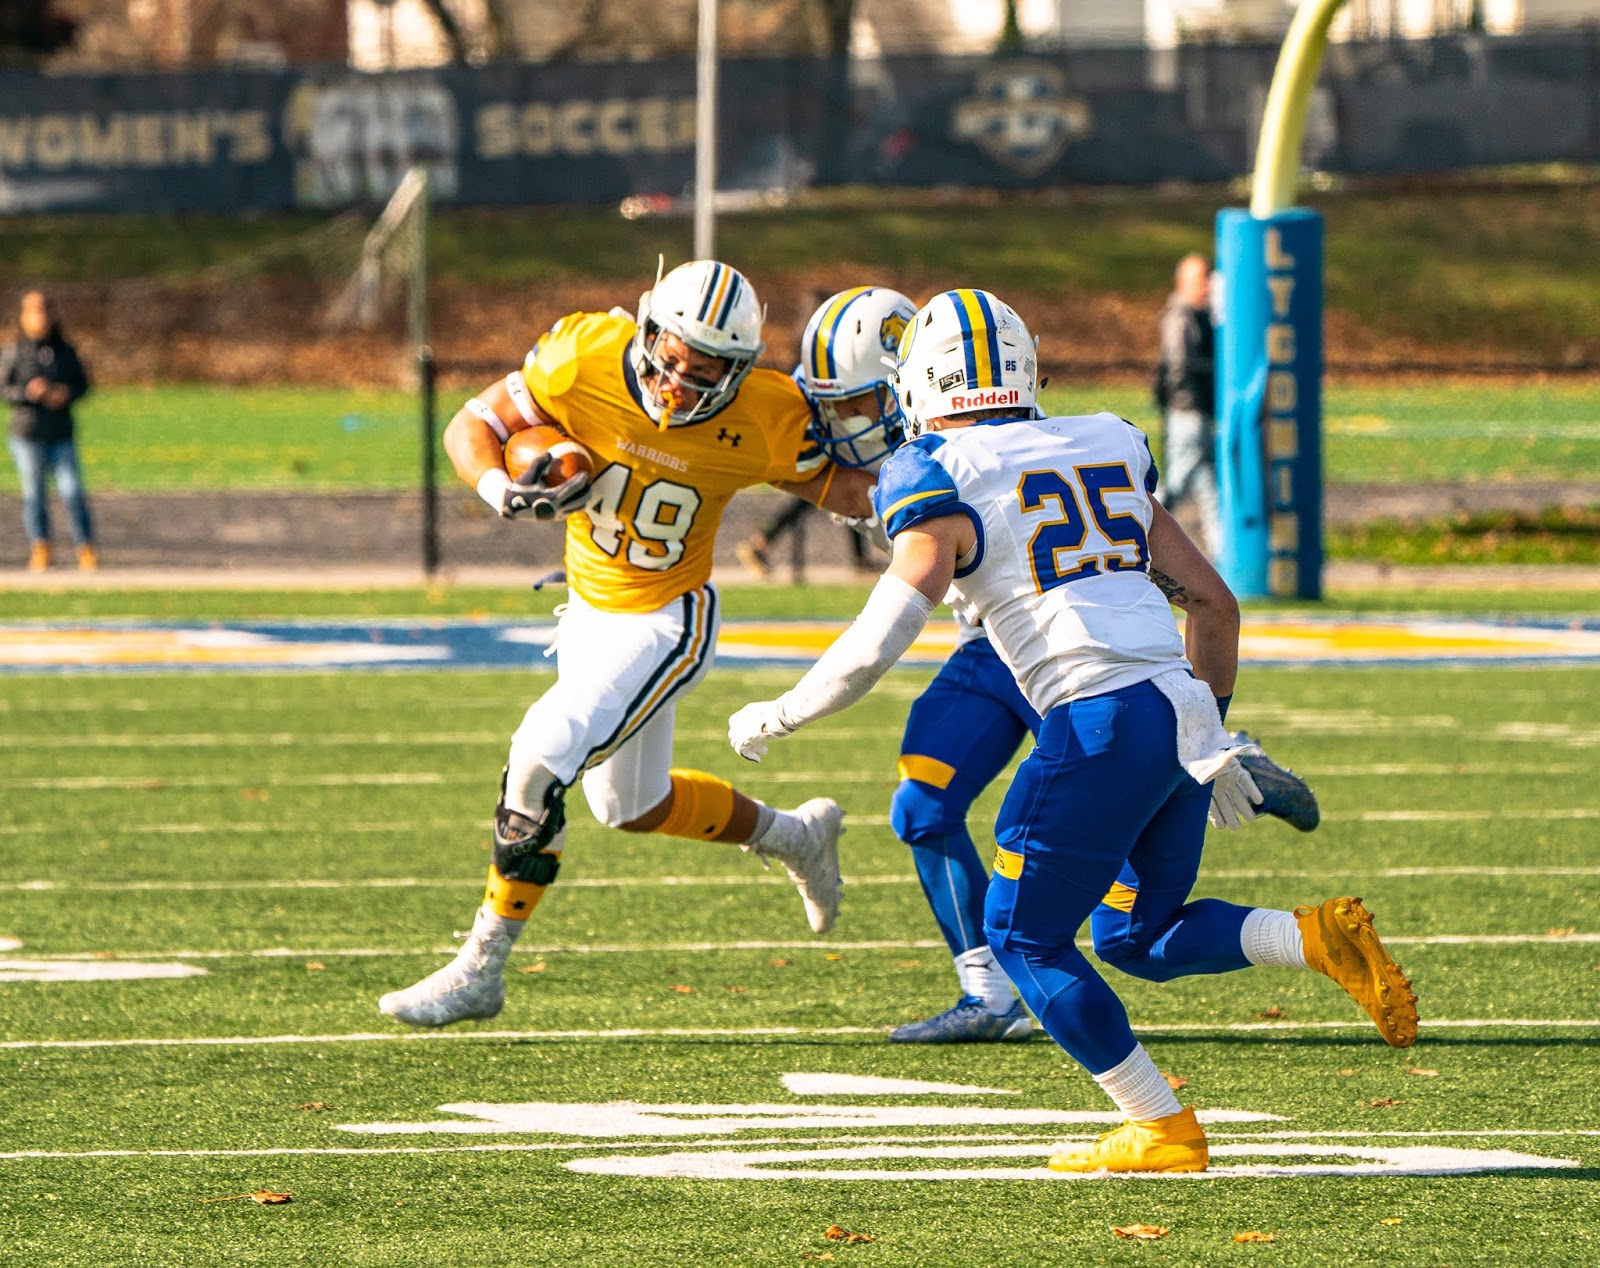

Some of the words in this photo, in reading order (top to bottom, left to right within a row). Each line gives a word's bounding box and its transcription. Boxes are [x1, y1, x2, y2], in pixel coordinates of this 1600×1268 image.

[1005, 360, 1017, 372] 25
[951, 390, 1019, 410] Riddell
[616, 437, 690, 473] WARRIORS
[585, 461, 702, 571] 49
[1016, 461, 1150, 596] 25
